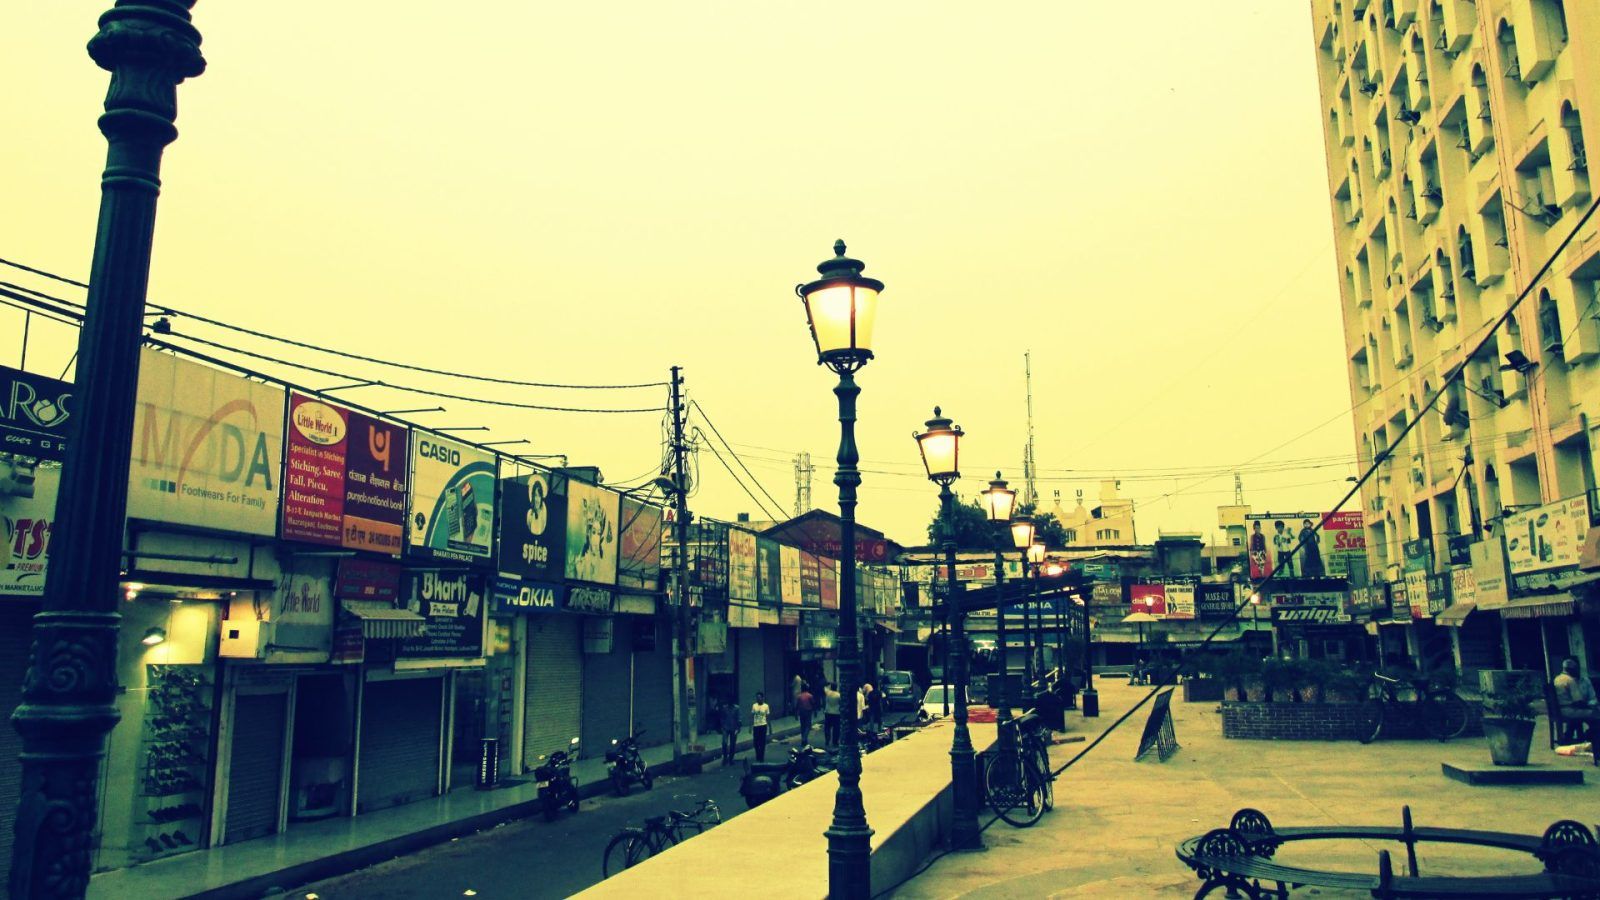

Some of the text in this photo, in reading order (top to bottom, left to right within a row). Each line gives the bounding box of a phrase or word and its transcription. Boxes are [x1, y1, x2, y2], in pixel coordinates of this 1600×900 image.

[315, 418, 332, 434] World
[141, 402, 272, 491] MODA
[420, 440, 460, 466] CASIO
[181, 483, 266, 510] Footwears For Family
[288, 490, 325, 506] Alteration
[522, 540, 548, 564] spice
[422, 573, 467, 601] Bharti
